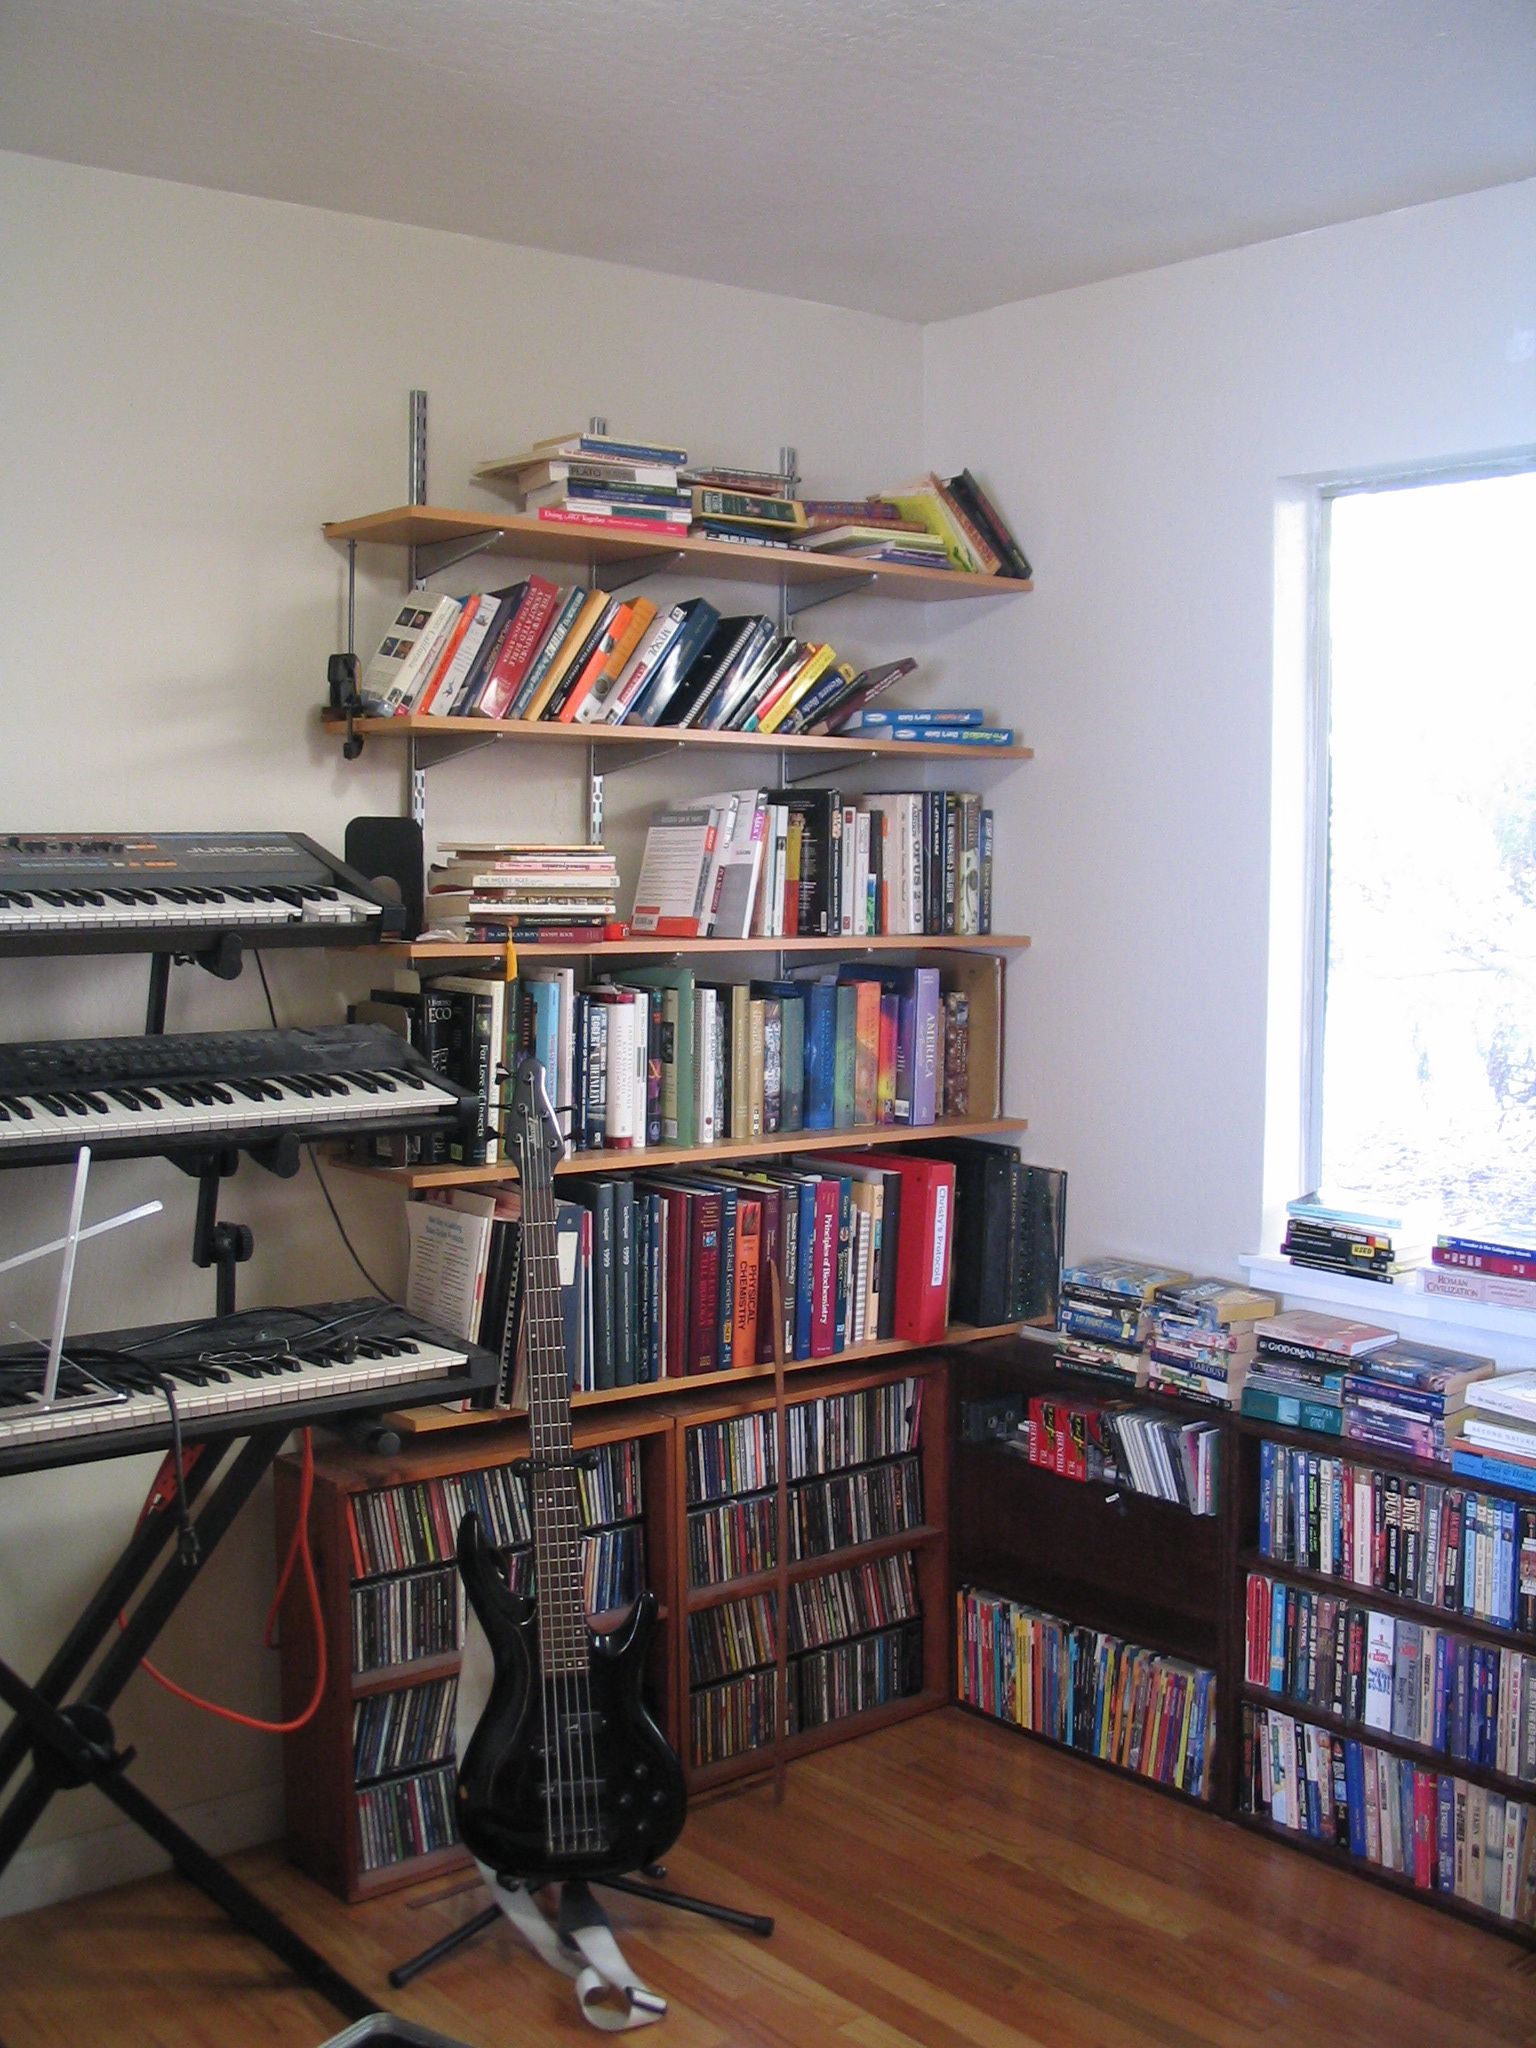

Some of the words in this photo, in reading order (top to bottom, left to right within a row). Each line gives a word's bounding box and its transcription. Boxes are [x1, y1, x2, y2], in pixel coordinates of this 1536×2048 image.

[913, 840, 921, 886] OPUS
[427, 1007, 453, 1024] ECO
[479, 1044, 488, 1062] For
[925, 1012, 935, 1078] AMERICA
[478, 1063, 487, 1086] Love
[477, 1102, 485, 1137] Insects
[935, 1187, 946, 1232] Christy's
[622, 1246, 630, 1265] 1999
[726, 1227, 734, 1272] Microbial
[822, 1214, 832, 1256] Principles
[933, 1235, 943, 1284] Protocols
[725, 1275, 733, 1315] Genetics
[738, 1261, 747, 1330] CHEMISTRY
[747, 1265, 756, 1324] PHYSICAL
[820, 1268, 830, 1324] Biochemistry
[1426, 1282, 1478, 1297] CIVILIZATION
[1437, 1275, 1468, 1286] ROMAN
[1188, 1361, 1225, 1378] STARDUST
[1029, 1419, 1037, 1462] maxell
[1056, 1430, 1064, 1473] maxell
[1385, 1492, 1398, 1527] DUNE
[1402, 1497, 1416, 1532] DUNE
